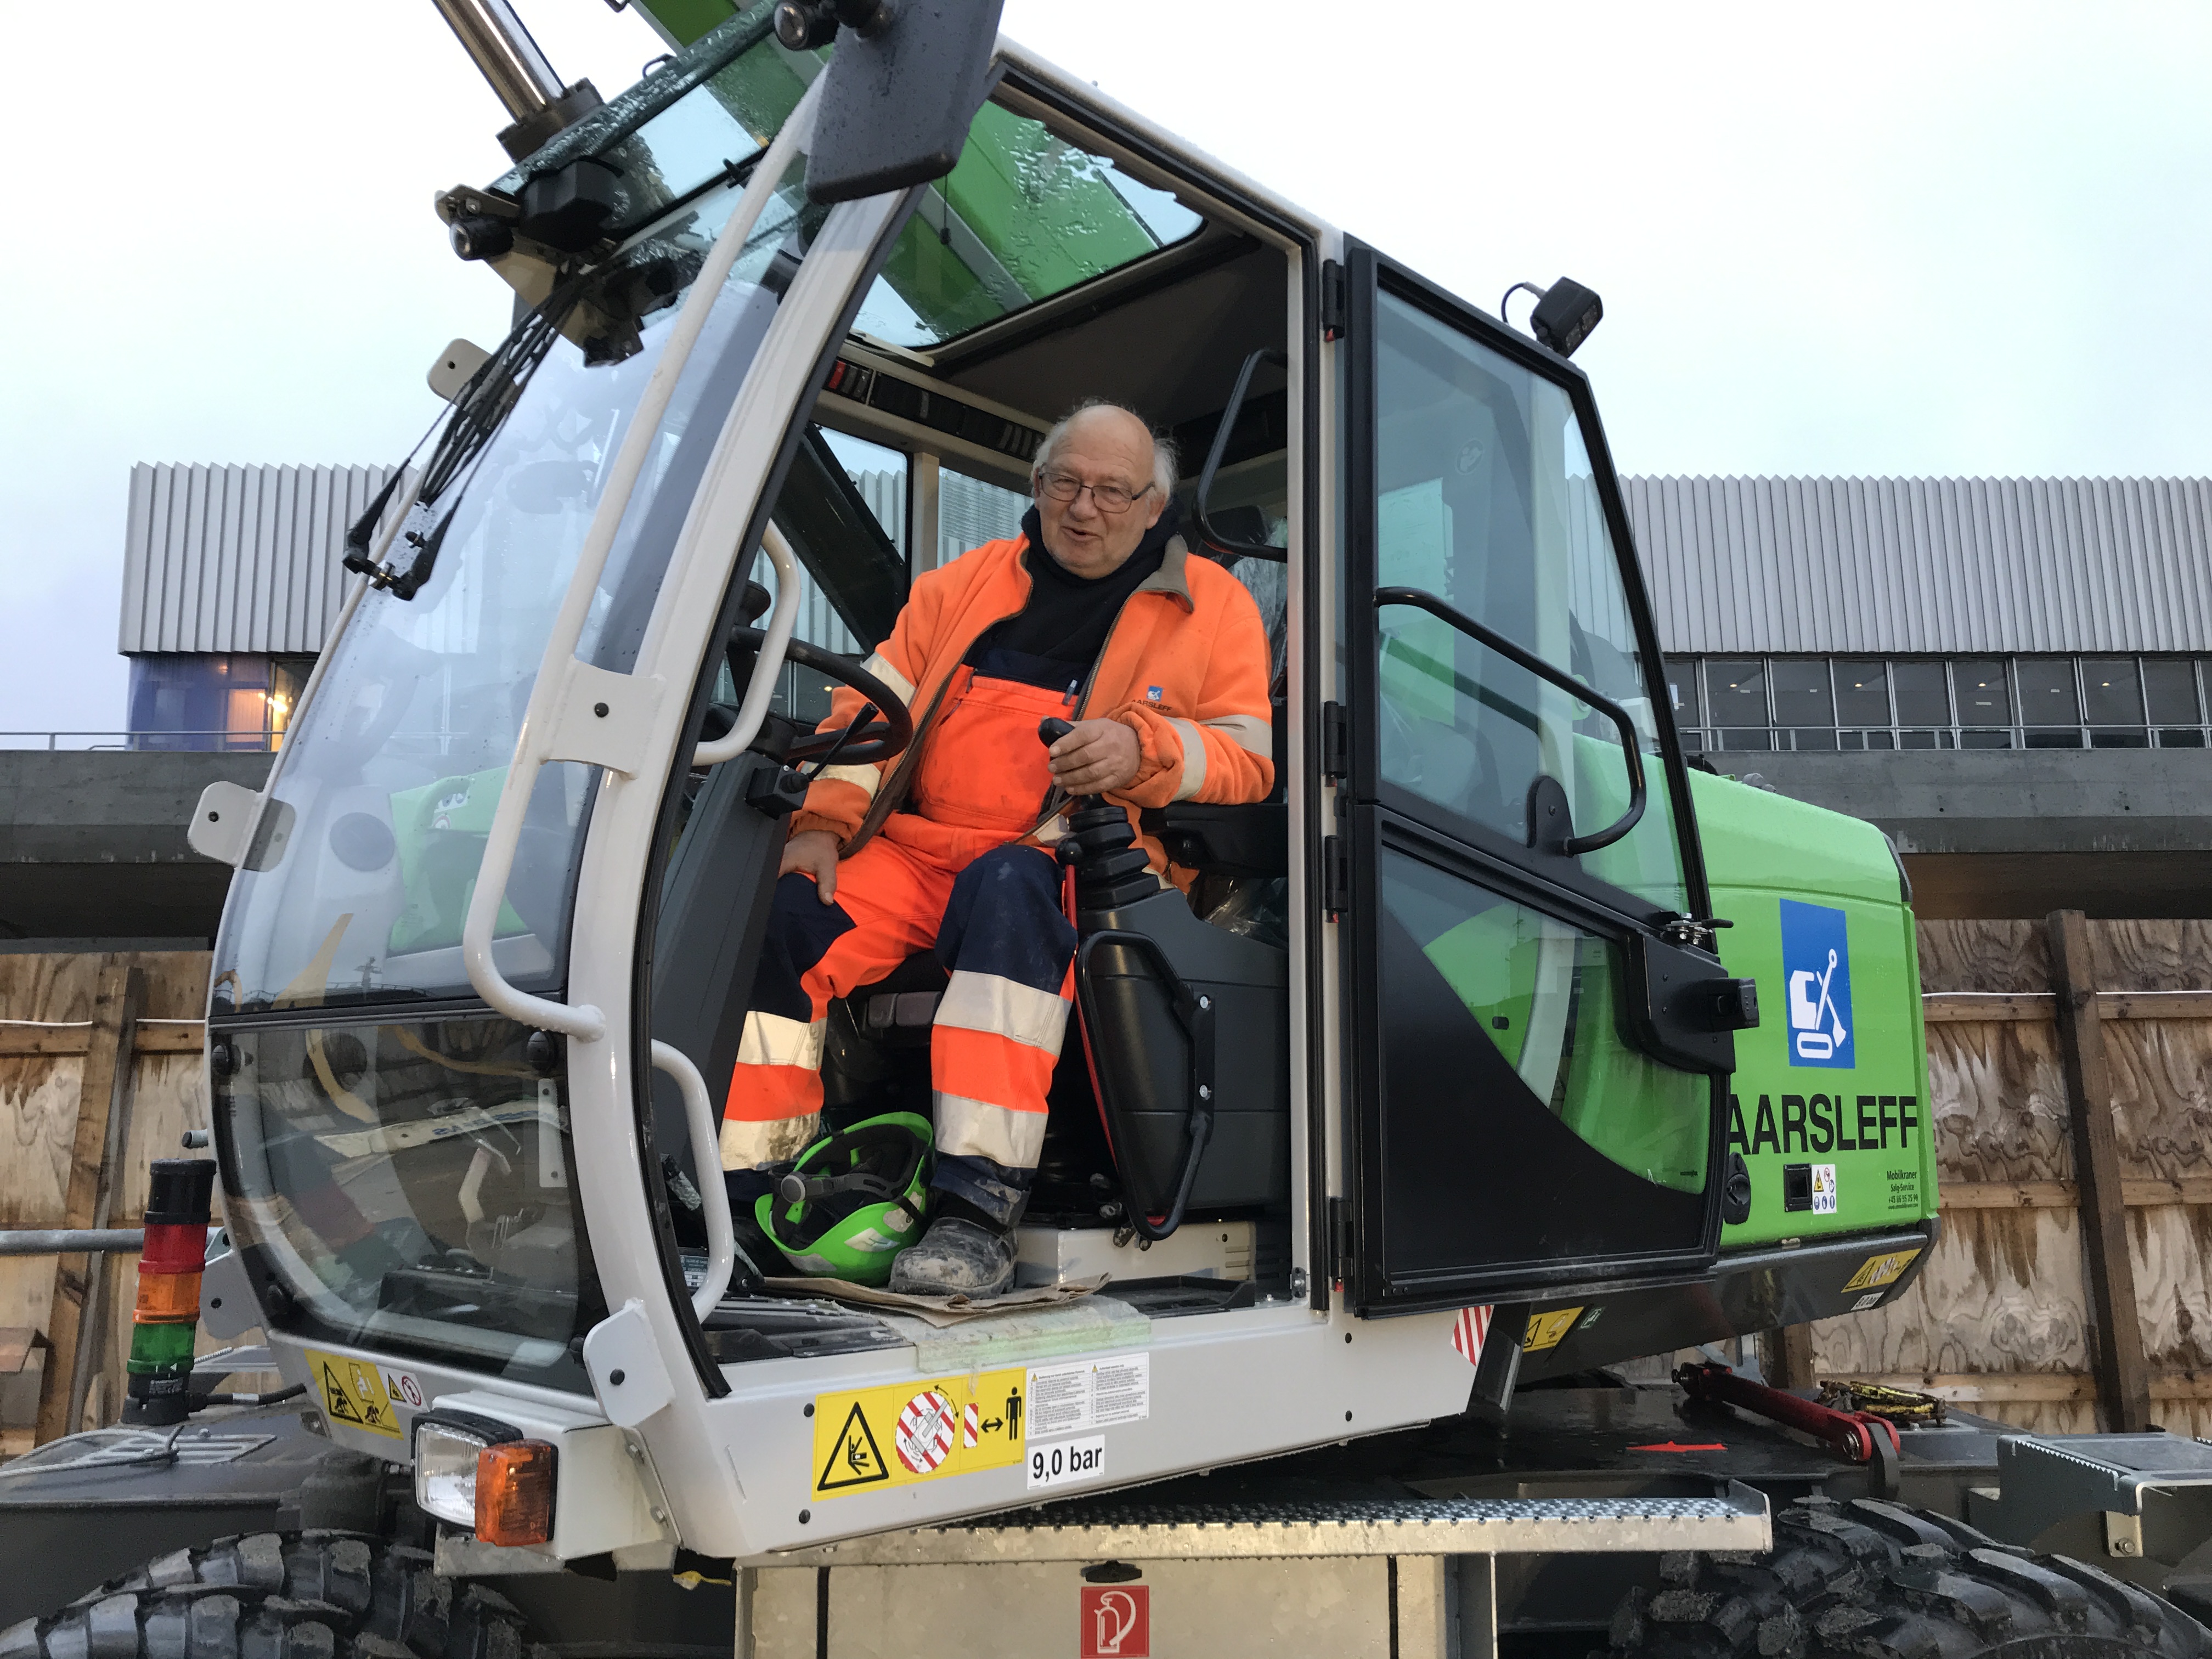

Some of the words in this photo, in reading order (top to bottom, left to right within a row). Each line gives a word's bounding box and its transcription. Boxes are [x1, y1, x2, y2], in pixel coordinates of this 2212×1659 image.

[1729, 1093, 1917, 1155] AARSLEFF
[1887, 1169, 1917, 1181] Mobilkraner
[1033, 1448, 1062, 1482] 9,0
[1070, 1446, 1102, 1472] bar
